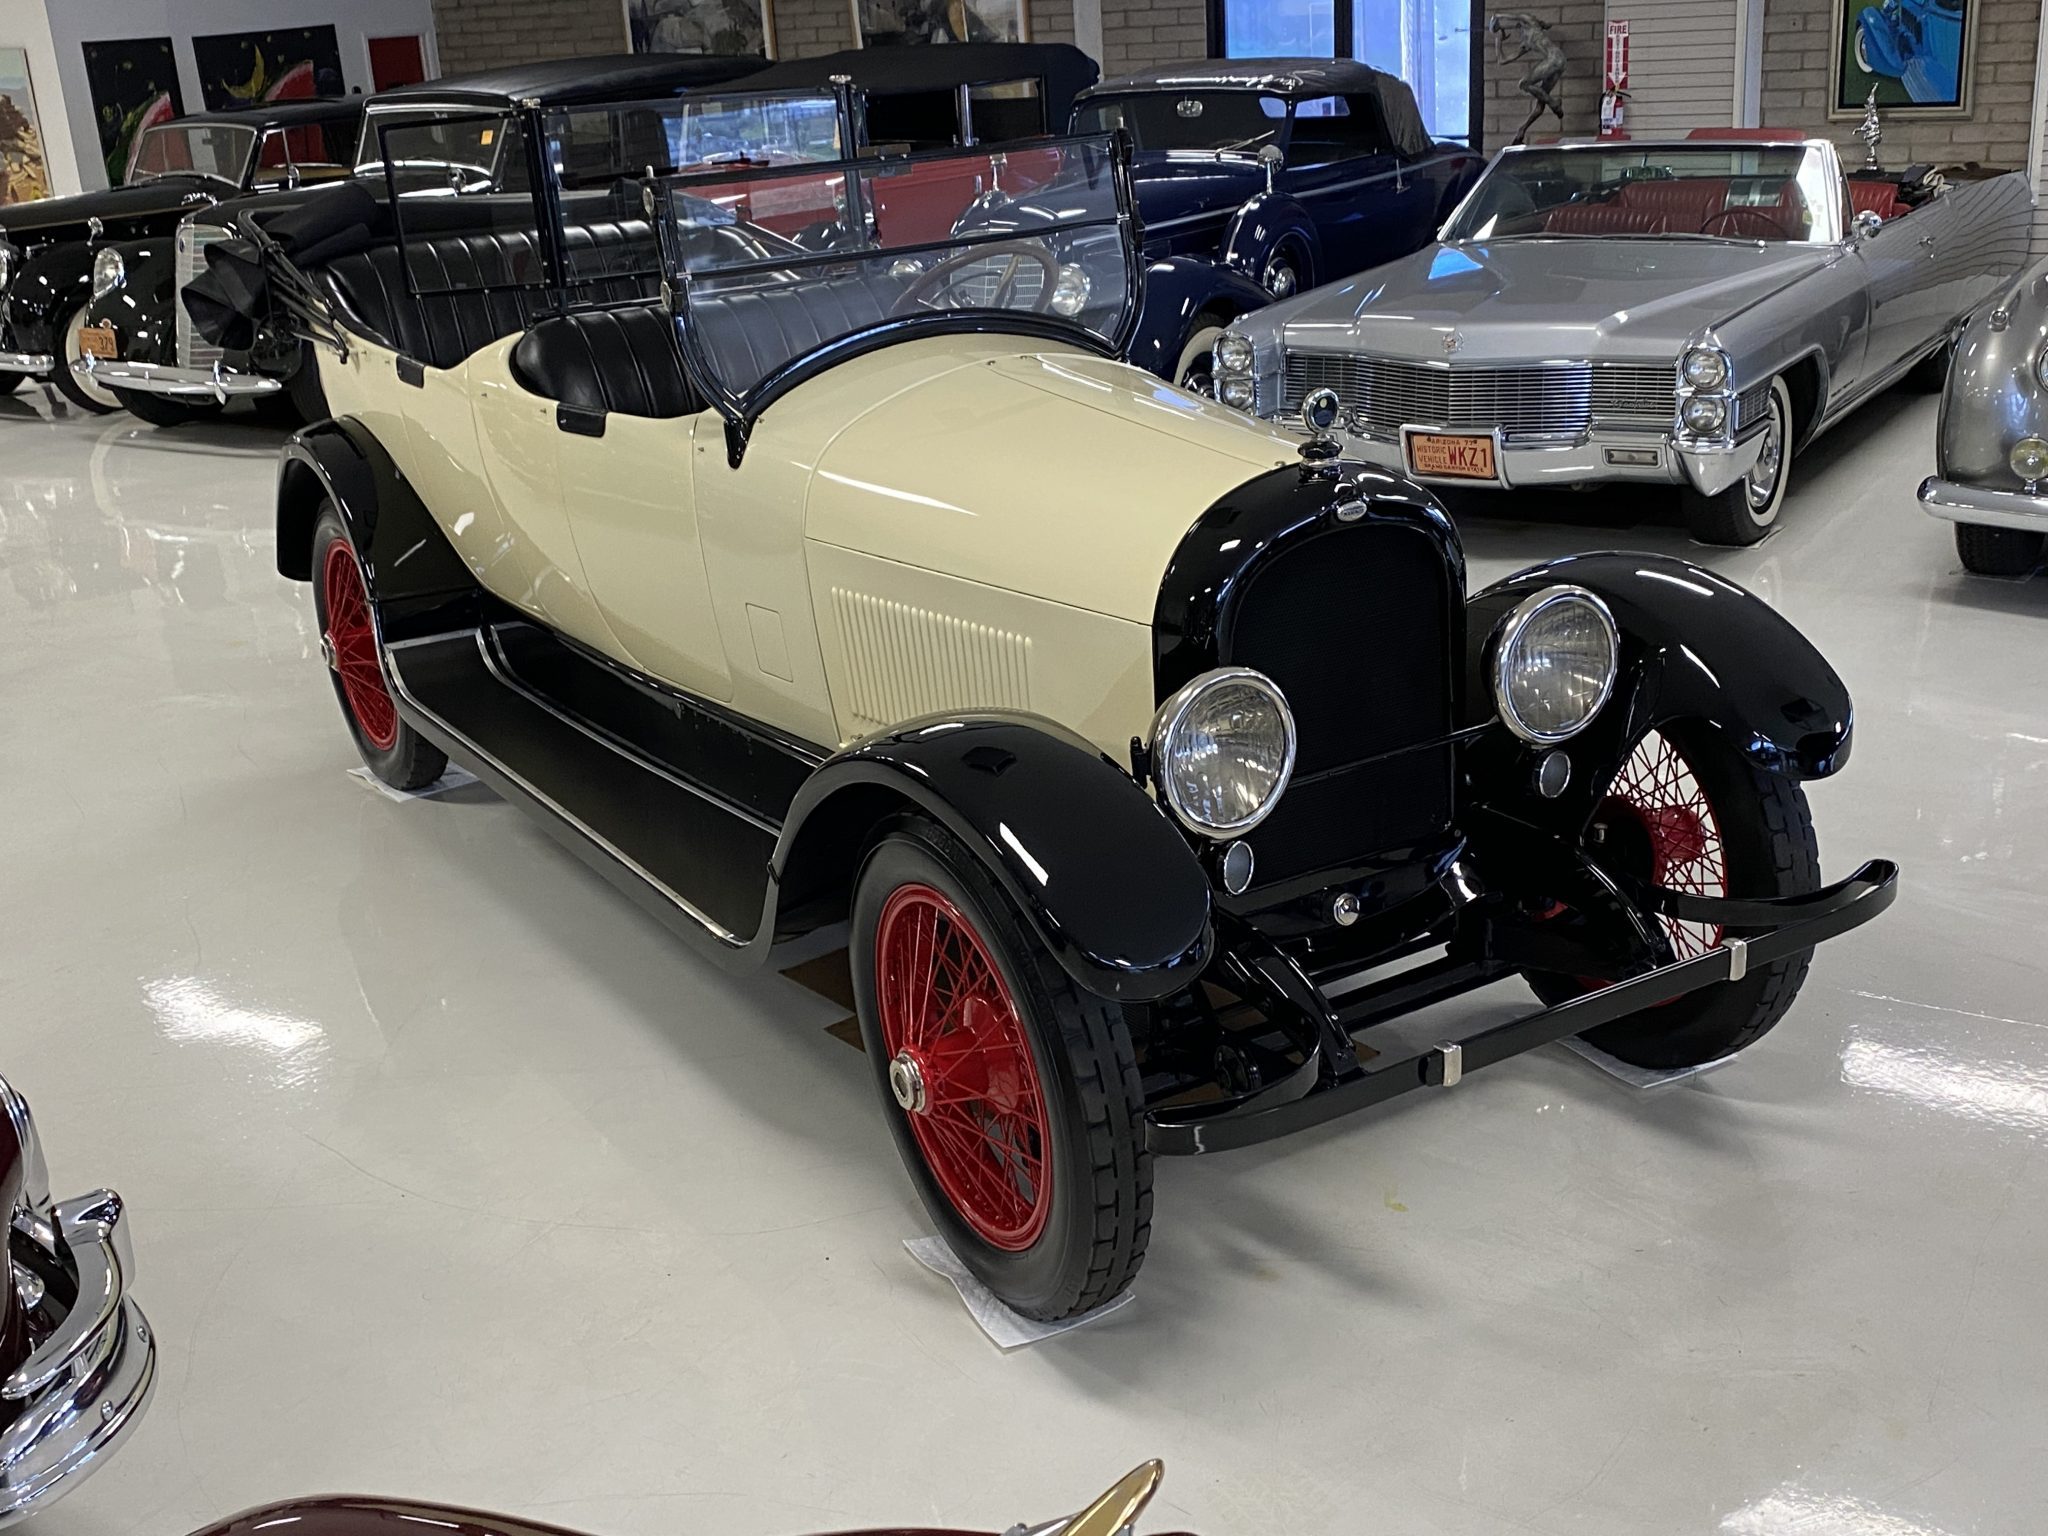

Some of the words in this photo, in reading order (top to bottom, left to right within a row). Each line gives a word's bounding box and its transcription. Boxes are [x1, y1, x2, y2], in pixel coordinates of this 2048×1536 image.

[1609, 24, 1627, 35] FIRE
[1431, 438, 1461, 446] ARIZONA
[1416, 445, 1447, 454] HISTORIC
[1418, 455, 1448, 464] VEHICLE
[1448, 446, 1488, 468] WKZ1
